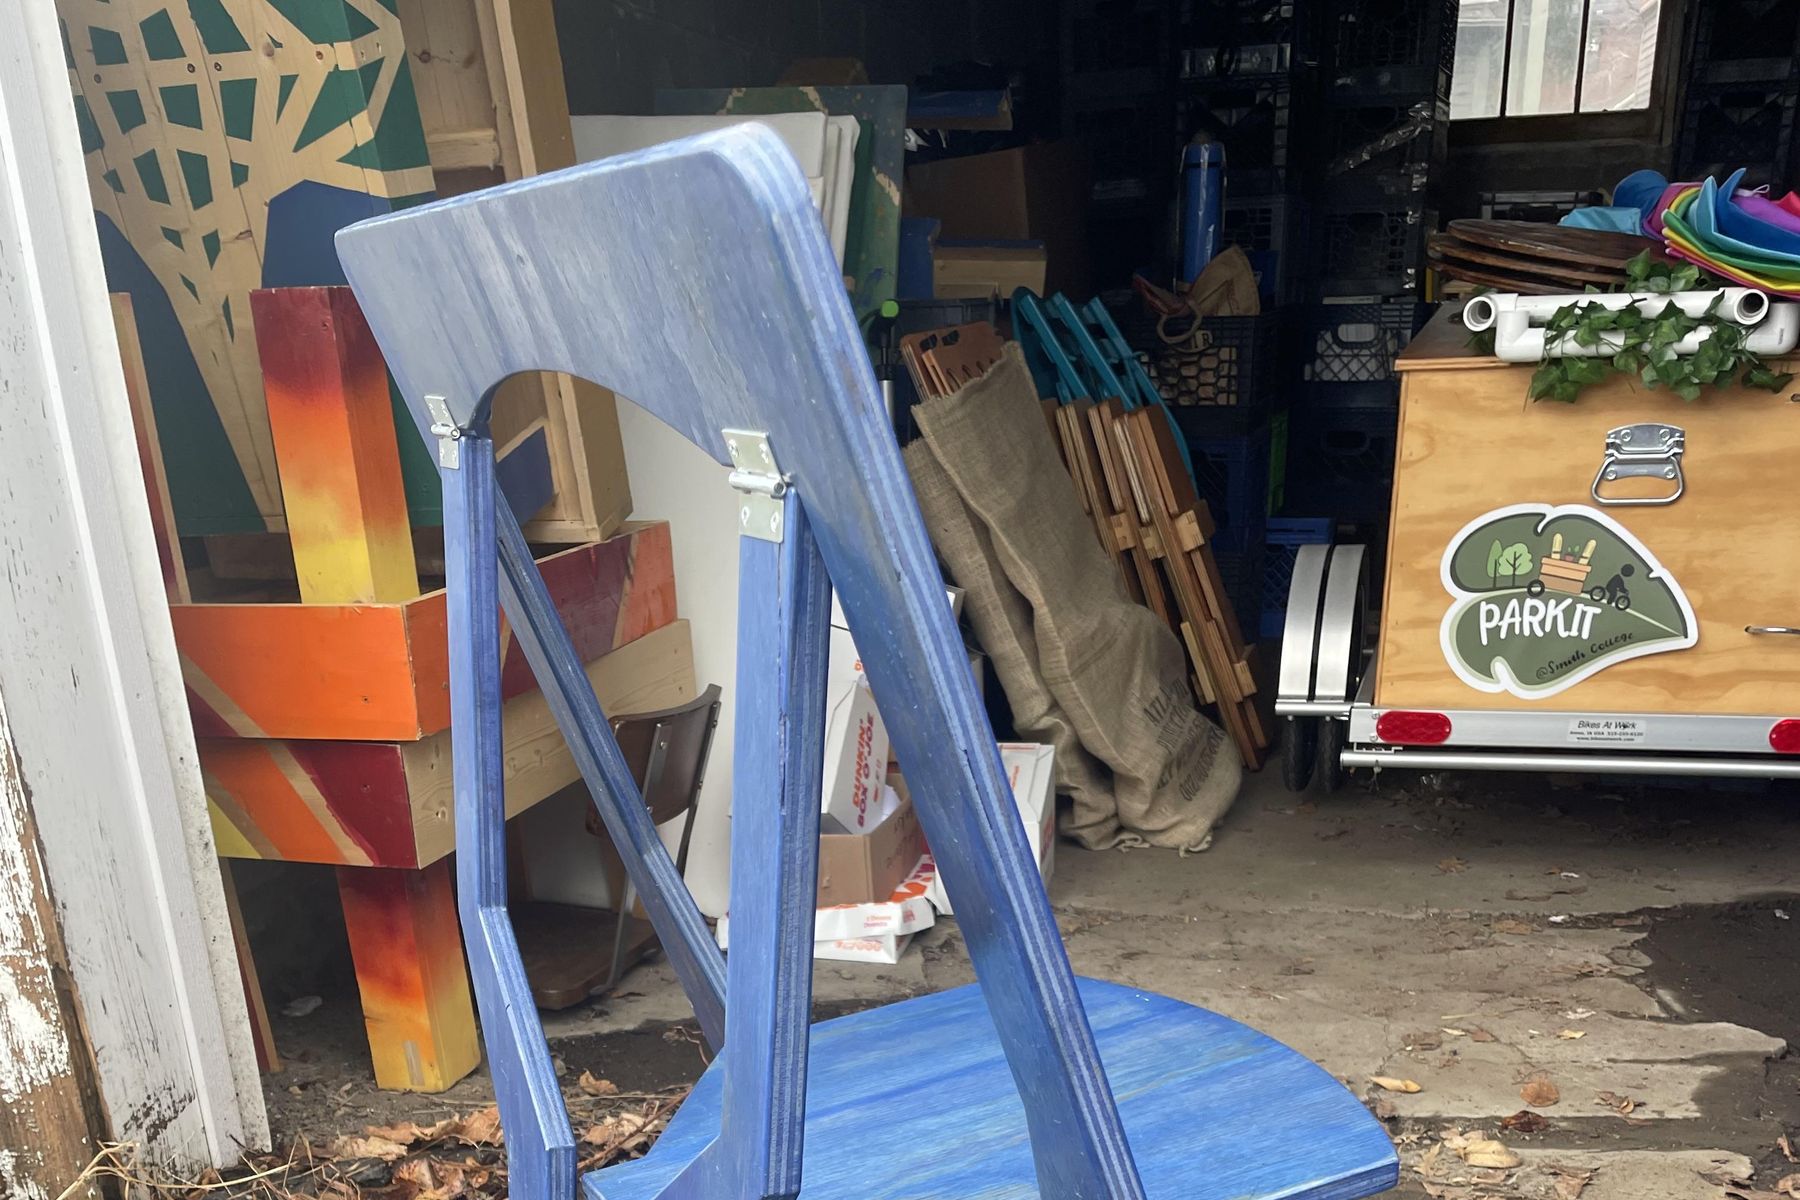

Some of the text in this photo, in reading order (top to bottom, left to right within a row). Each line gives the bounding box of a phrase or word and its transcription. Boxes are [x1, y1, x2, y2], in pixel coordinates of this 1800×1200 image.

[1480, 598, 1601, 646] PARKIT
[1577, 720, 1601, 729] Bikes
[1602, 721, 1613, 729] At
[858, 783, 868, 828] BOX
